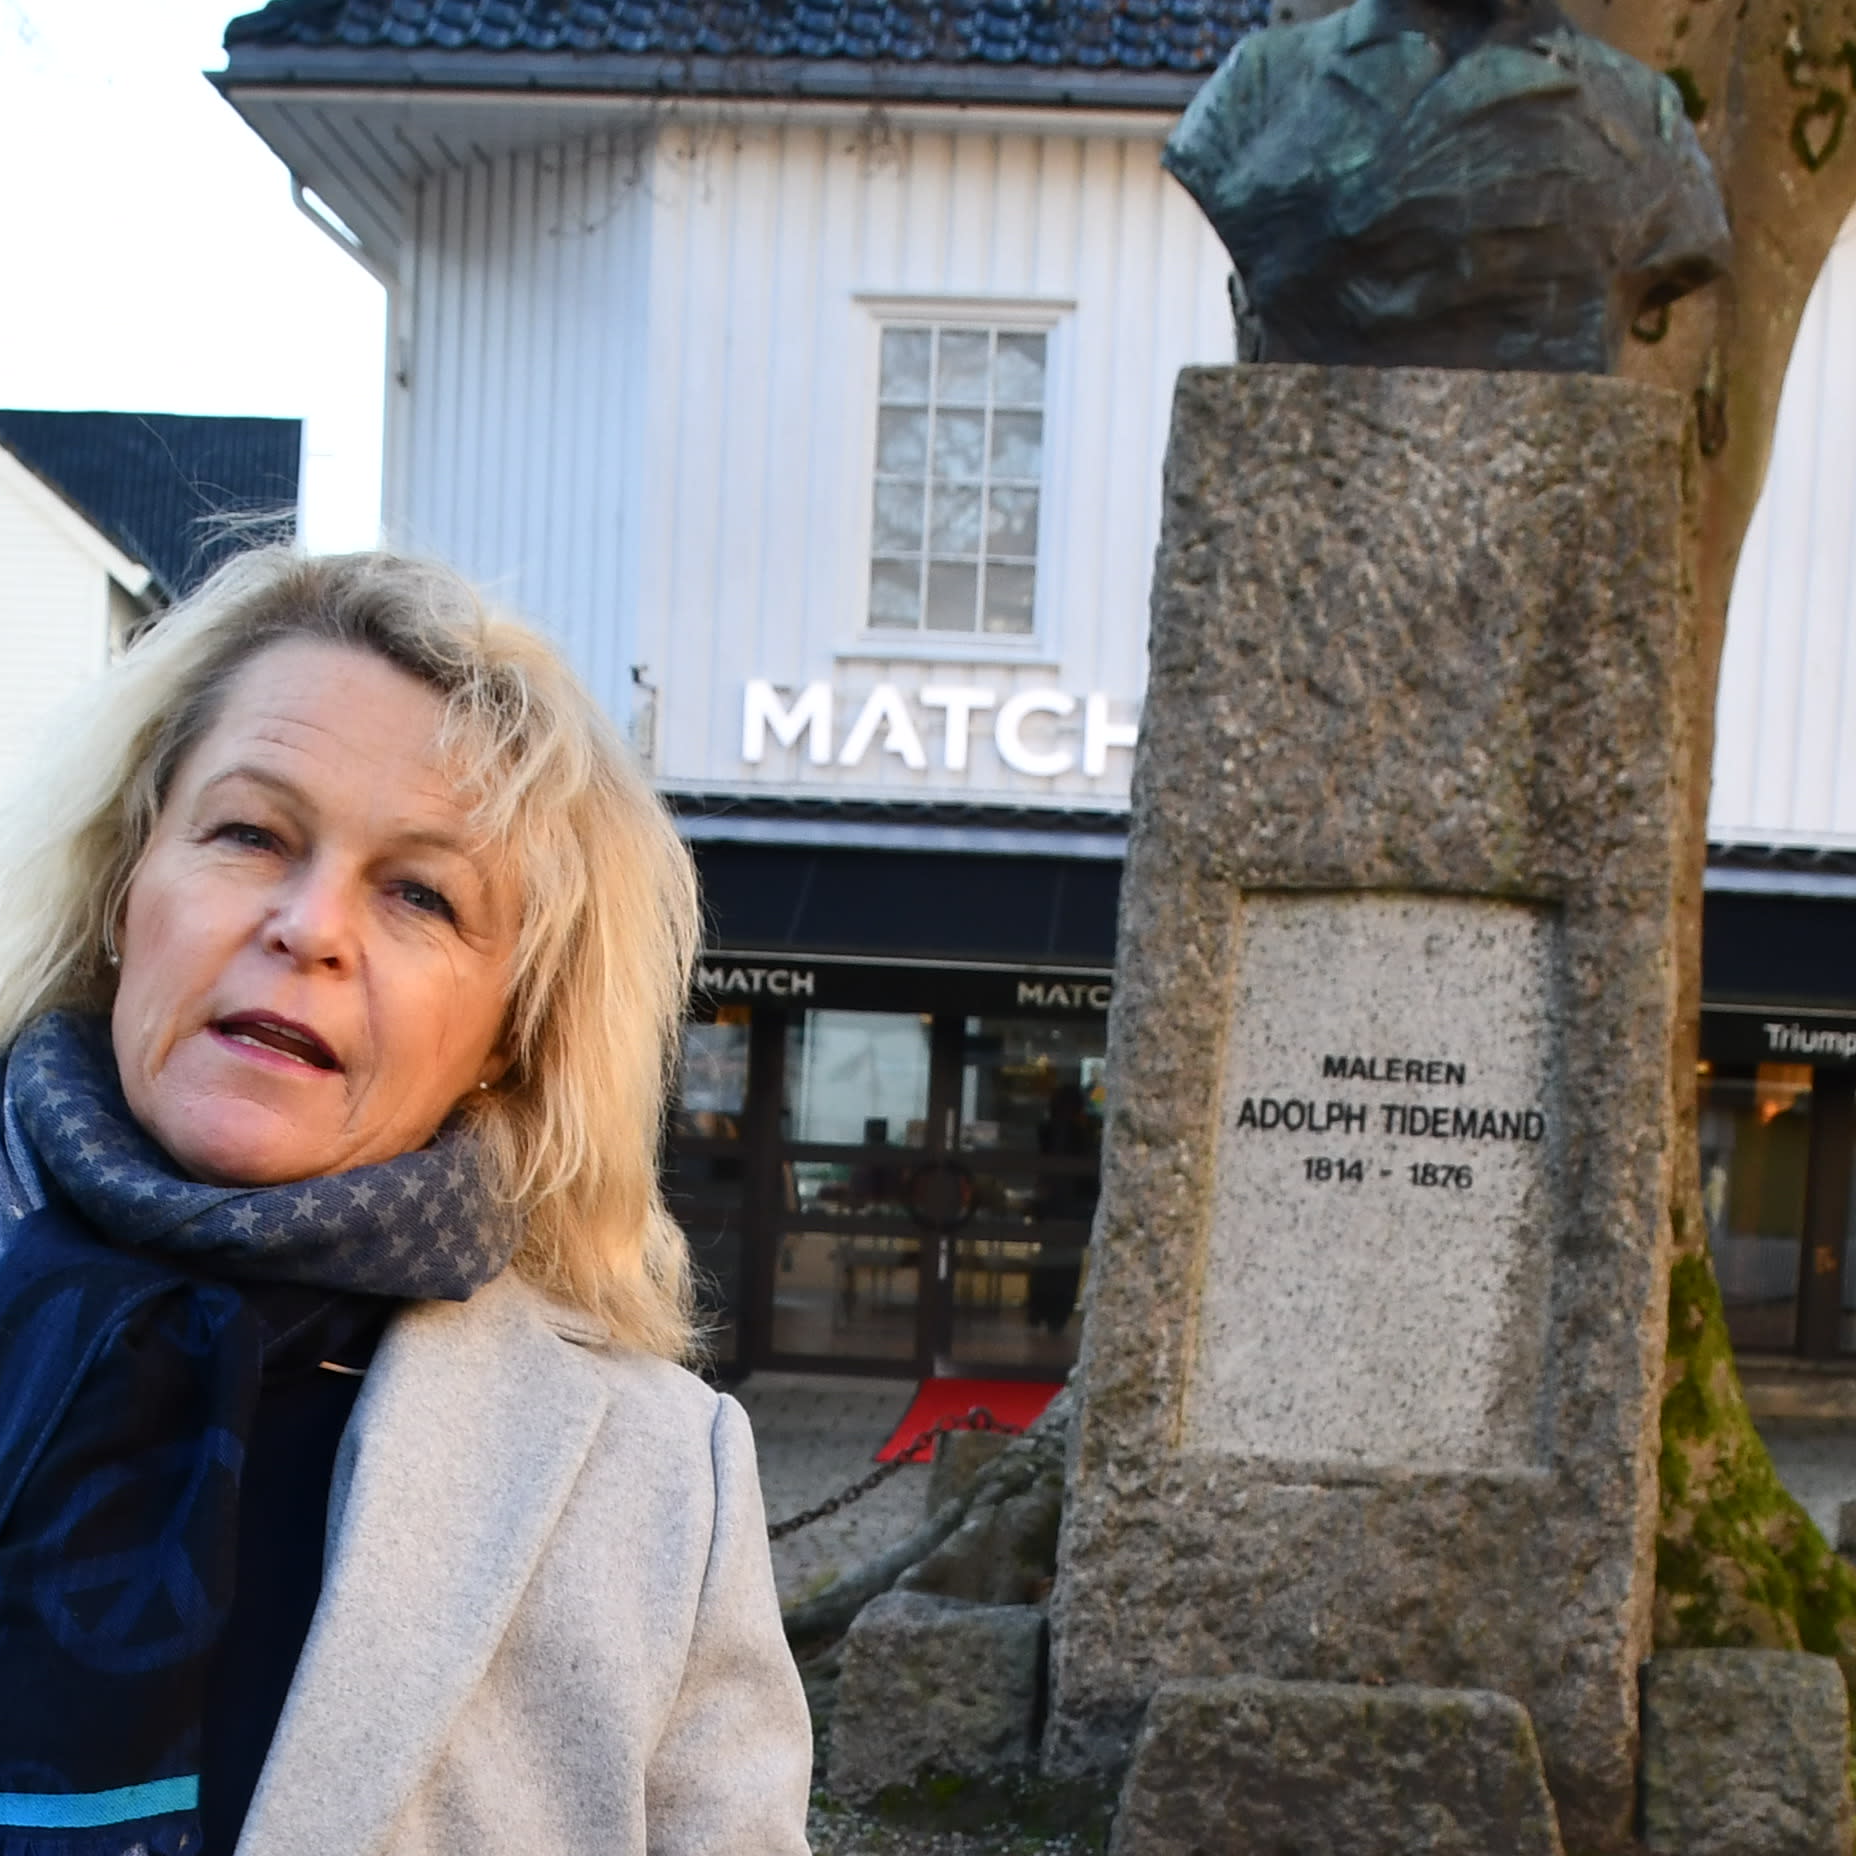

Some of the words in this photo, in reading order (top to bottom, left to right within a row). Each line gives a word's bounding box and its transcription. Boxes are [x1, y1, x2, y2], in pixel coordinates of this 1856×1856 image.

[742, 678, 1140, 777] MATCH
[697, 966, 815, 995] MATCH
[1017, 981, 1112, 1009] MATC
[1322, 1054, 1466, 1085] MALEREN
[1237, 1097, 1366, 1134] ADOLPH
[1380, 1103, 1544, 1141] TIDEMAND
[1304, 1157, 1364, 1183] 1814
[1409, 1163, 1473, 1189] 1876
